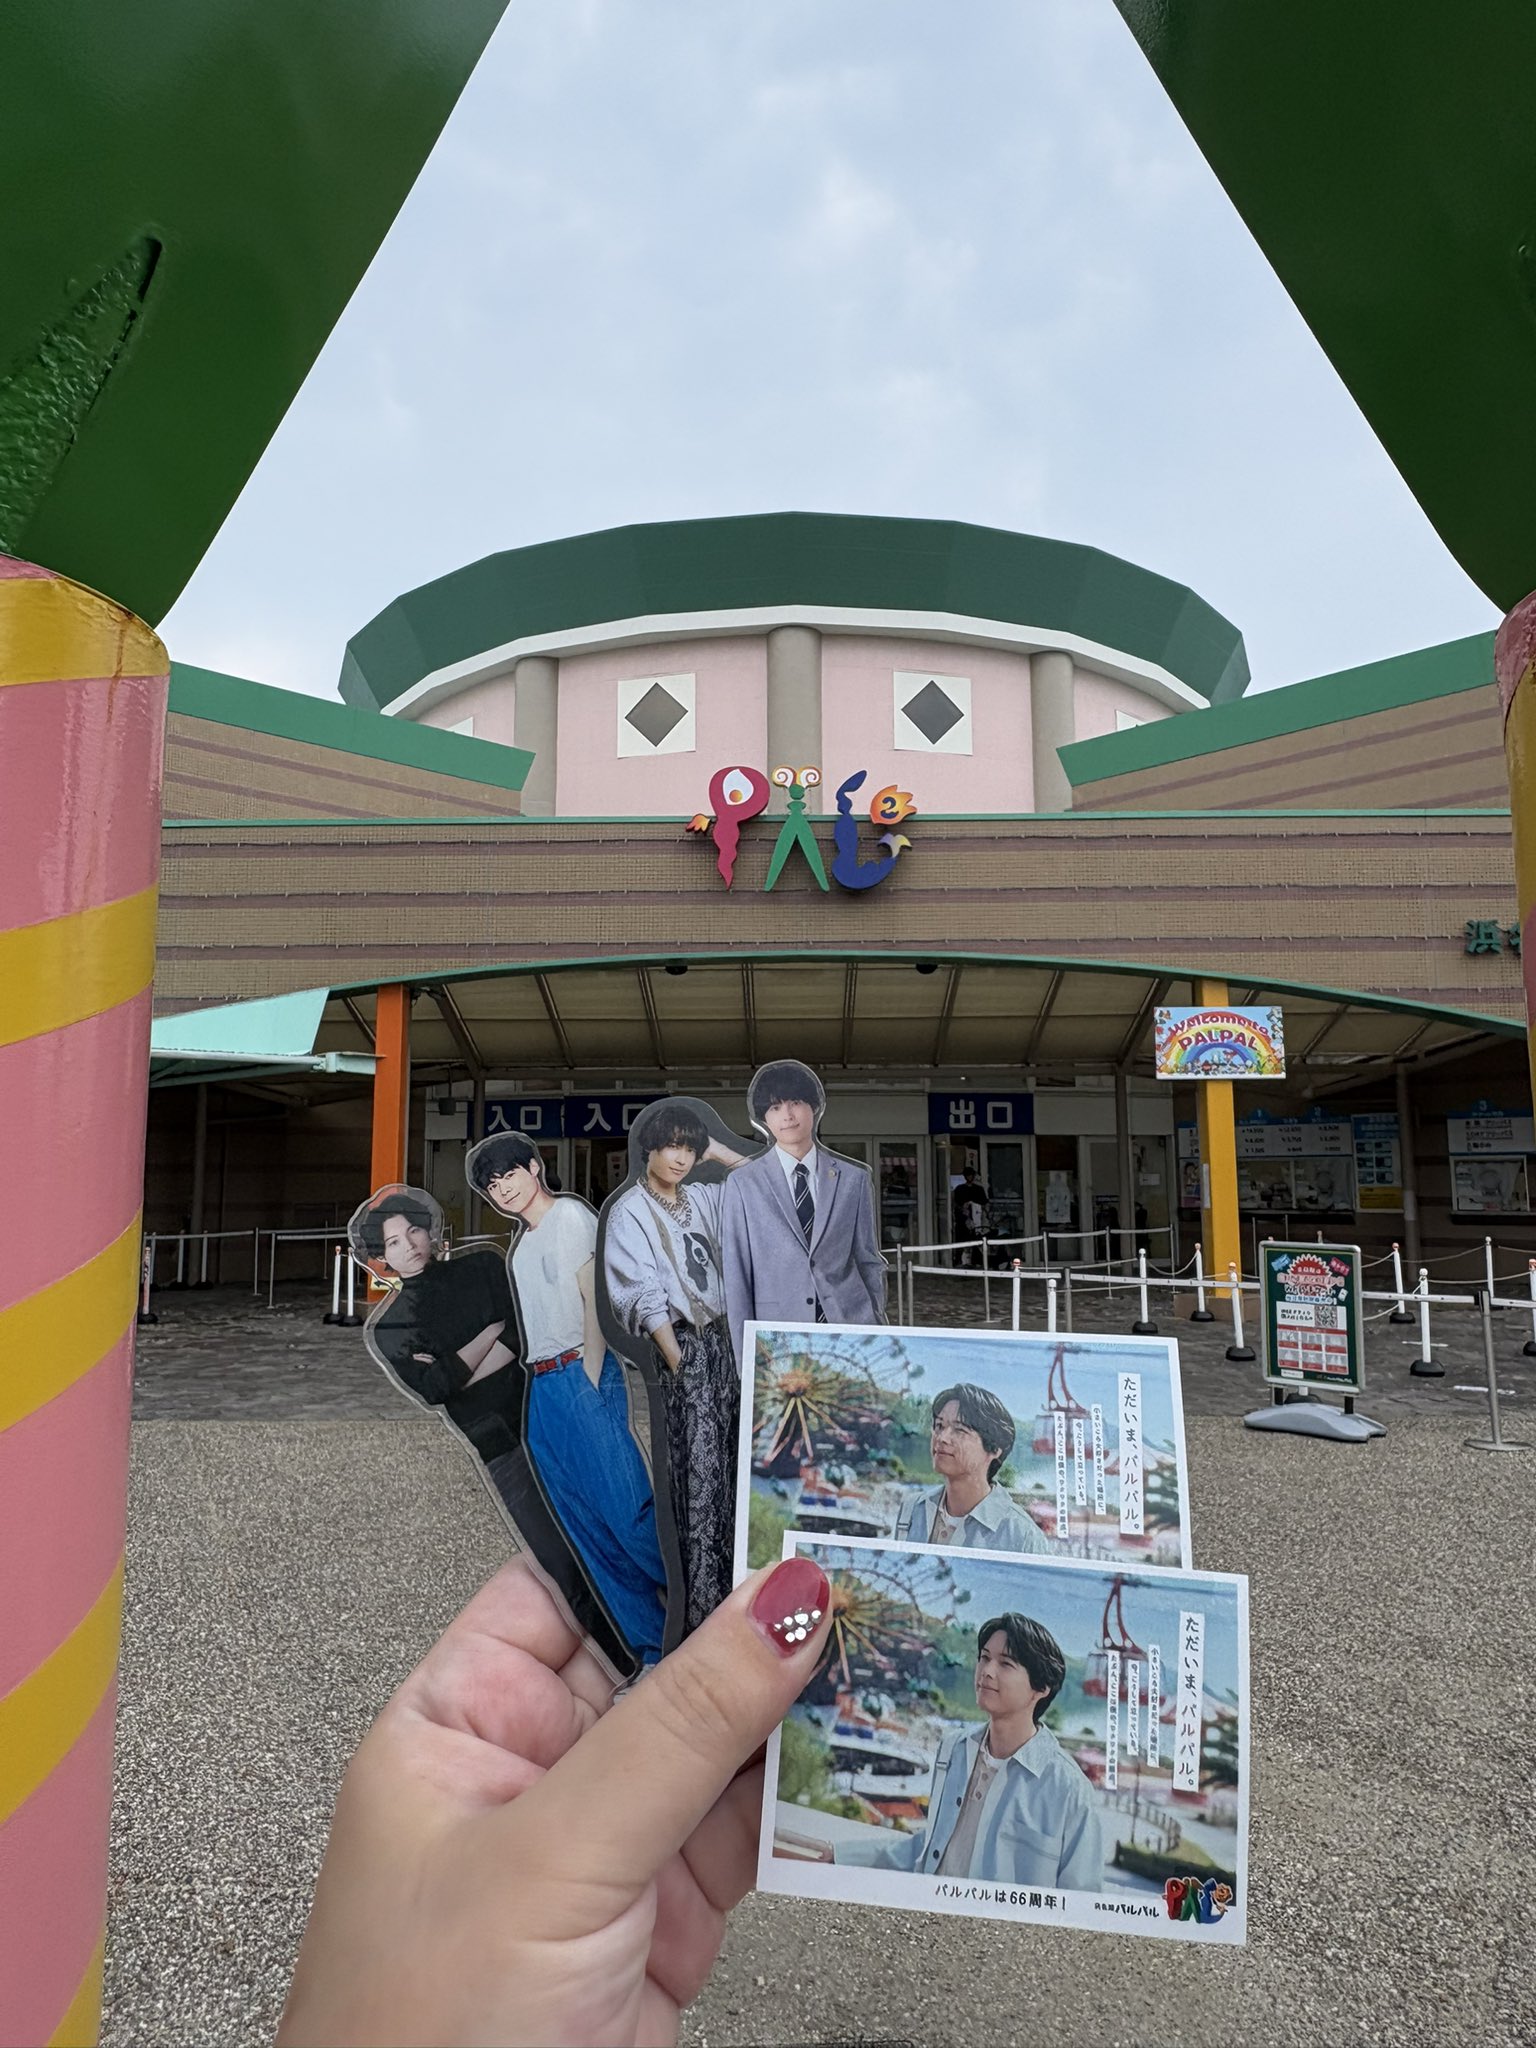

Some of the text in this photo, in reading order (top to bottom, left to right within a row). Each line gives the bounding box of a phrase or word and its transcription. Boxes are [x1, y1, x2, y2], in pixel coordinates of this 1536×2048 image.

[1168, 1014, 1269, 1036] Welcome to
[1178, 1029, 1259, 1051] PALPAL
[488, 1105, 542, 1131] 入口
[949, 1099, 1013, 1129] 出口
